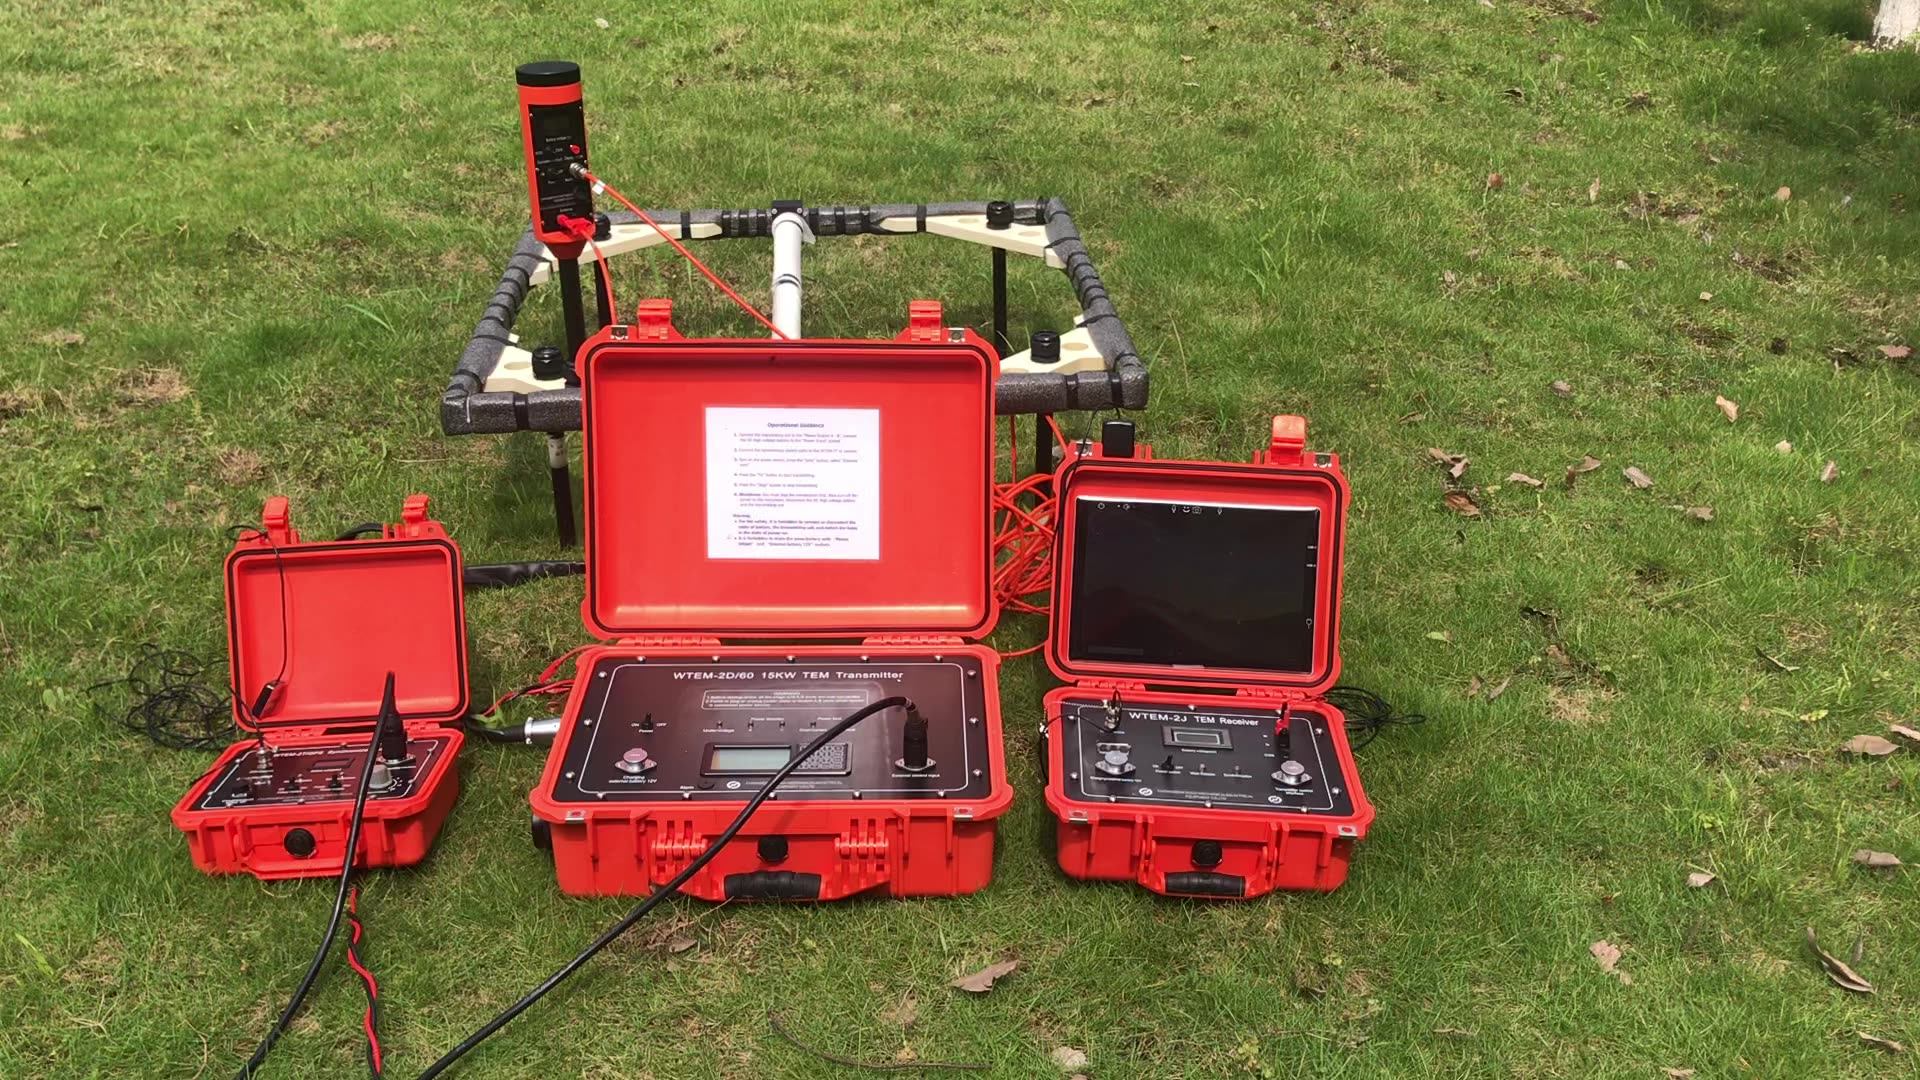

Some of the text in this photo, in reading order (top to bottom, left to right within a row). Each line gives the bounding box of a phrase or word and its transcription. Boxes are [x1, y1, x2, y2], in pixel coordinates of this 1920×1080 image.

[673, 671, 904, 680] WTEM-2D/60 15KW TEM Transmitter
[1129, 711, 1260, 726] WTEM-2J TEM Receiver
